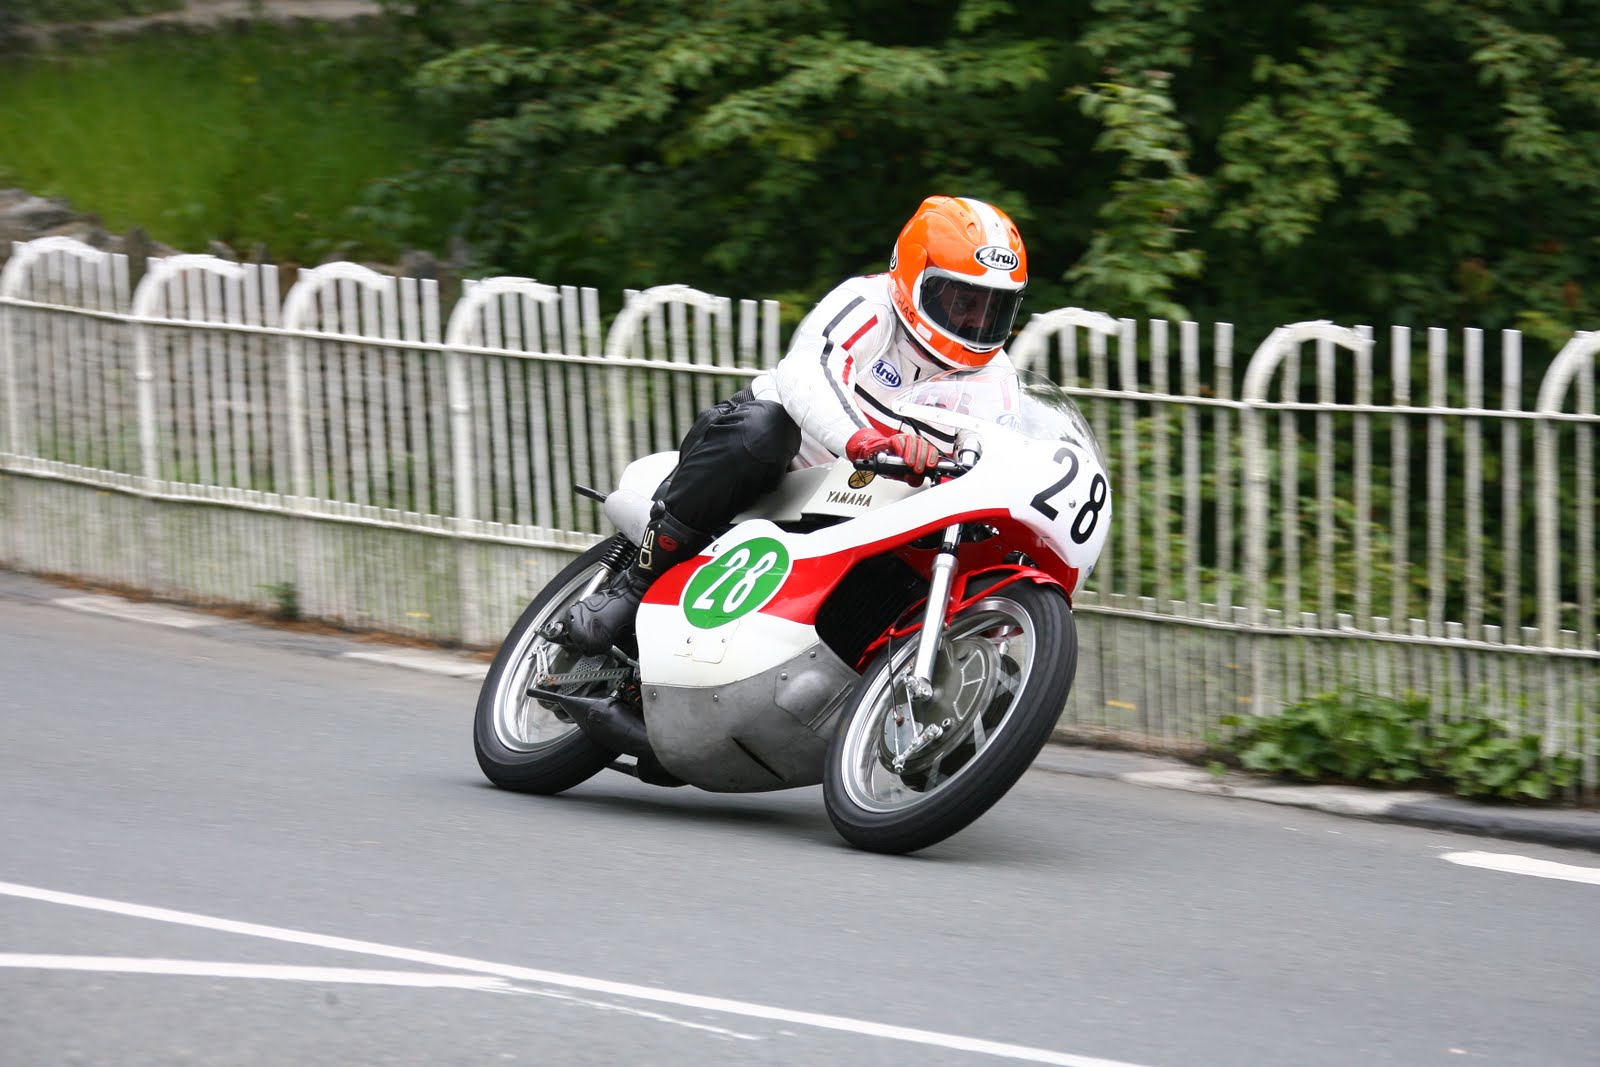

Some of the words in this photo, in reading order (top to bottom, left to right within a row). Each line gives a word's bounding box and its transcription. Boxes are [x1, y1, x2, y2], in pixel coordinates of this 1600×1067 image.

[979, 248, 1014, 265] Arai
[873, 362, 898, 384] Arai
[826, 491, 873, 507] YAMAHA
[1030, 447, 1107, 545] 28
[692, 548, 778, 613] 28
